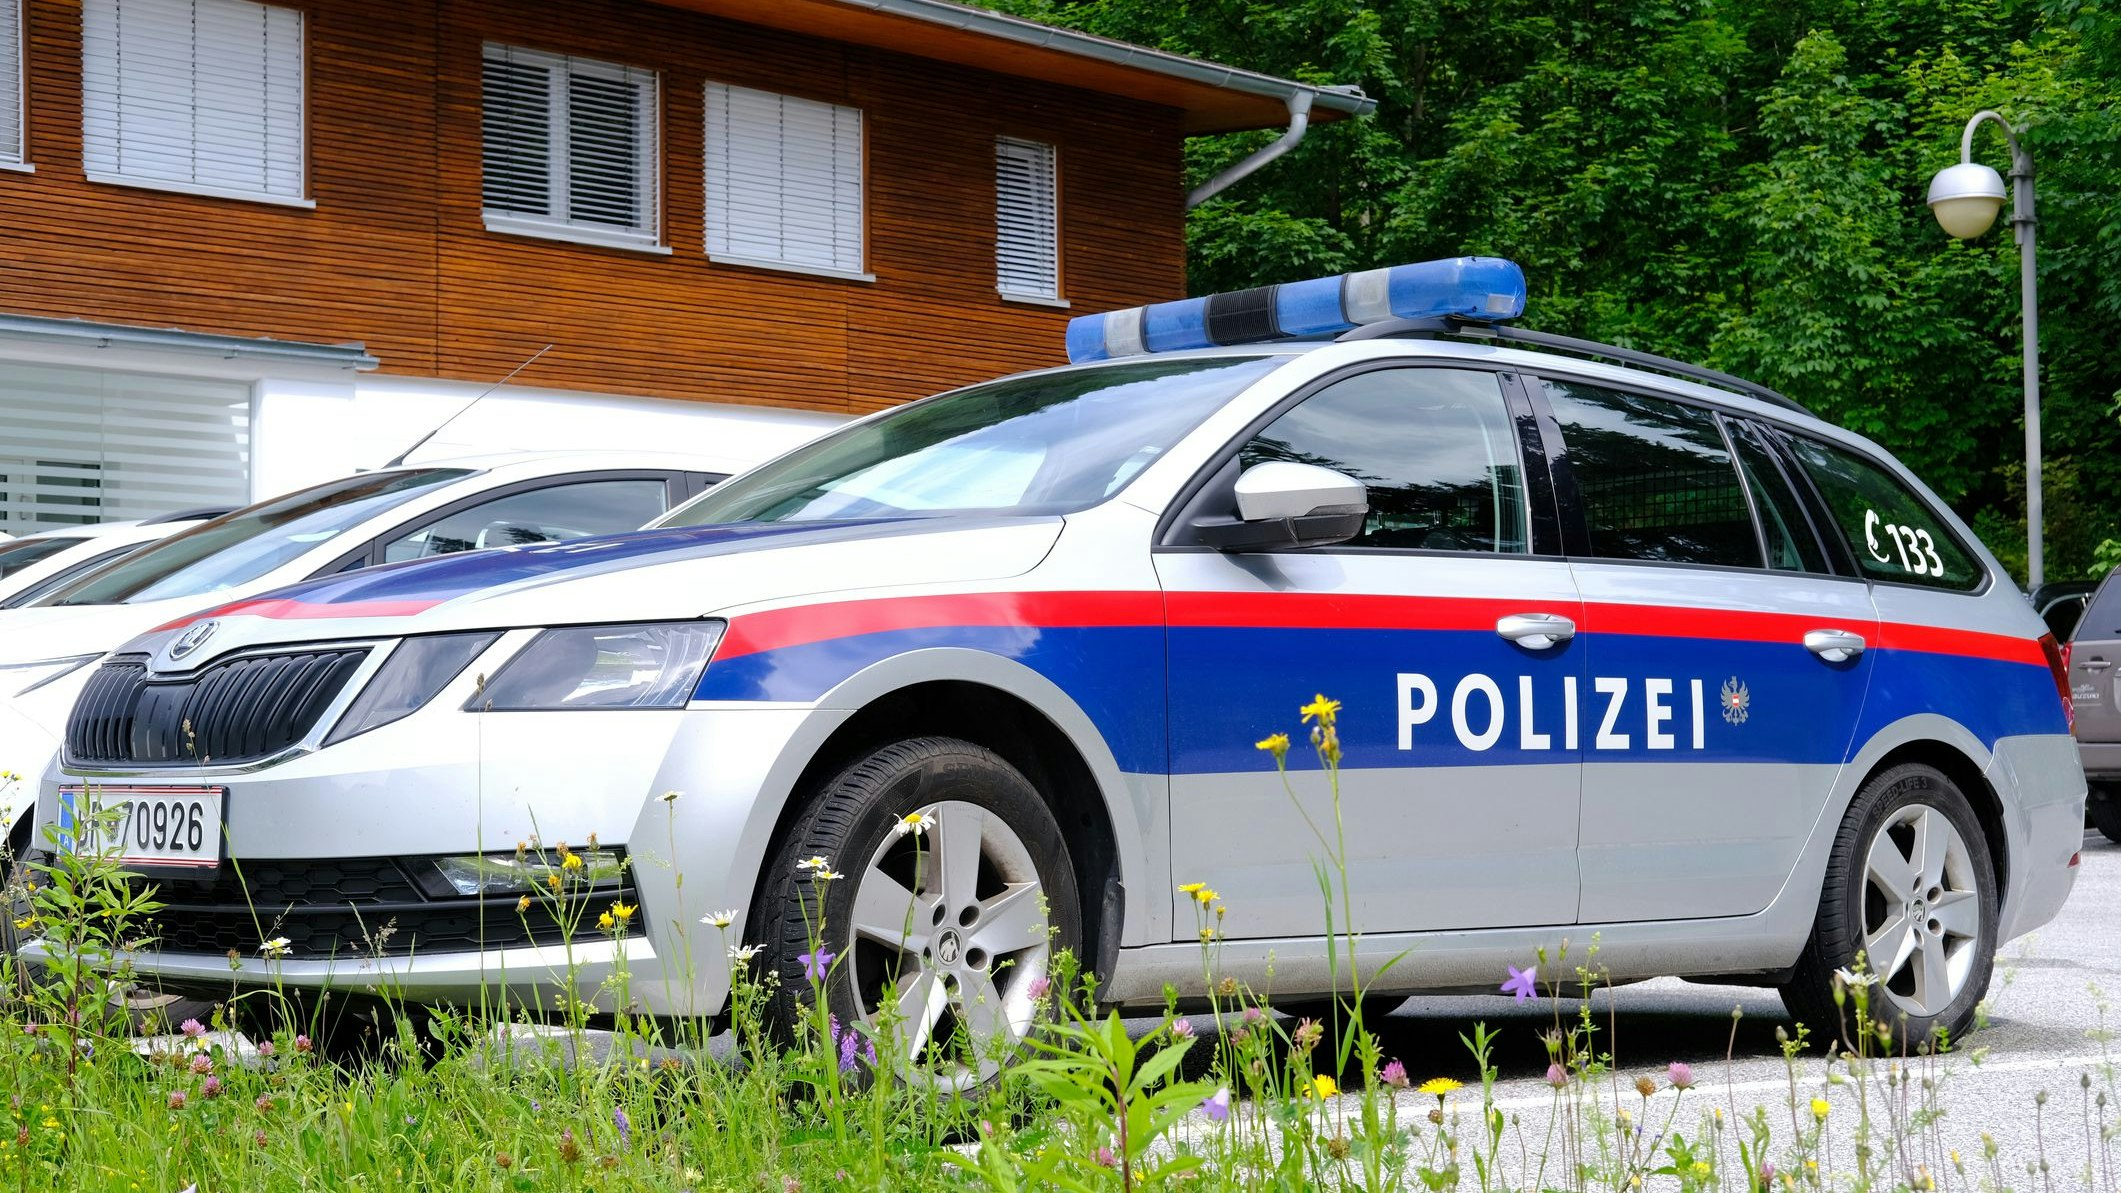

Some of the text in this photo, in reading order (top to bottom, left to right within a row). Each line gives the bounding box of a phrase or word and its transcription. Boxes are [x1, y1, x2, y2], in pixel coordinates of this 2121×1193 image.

[1885, 524, 1944, 577] 133
[1397, 673, 1705, 751] POLIZEI
[1921, 777, 1928, 789] 3
[122, 801, 204, 850] 70926
